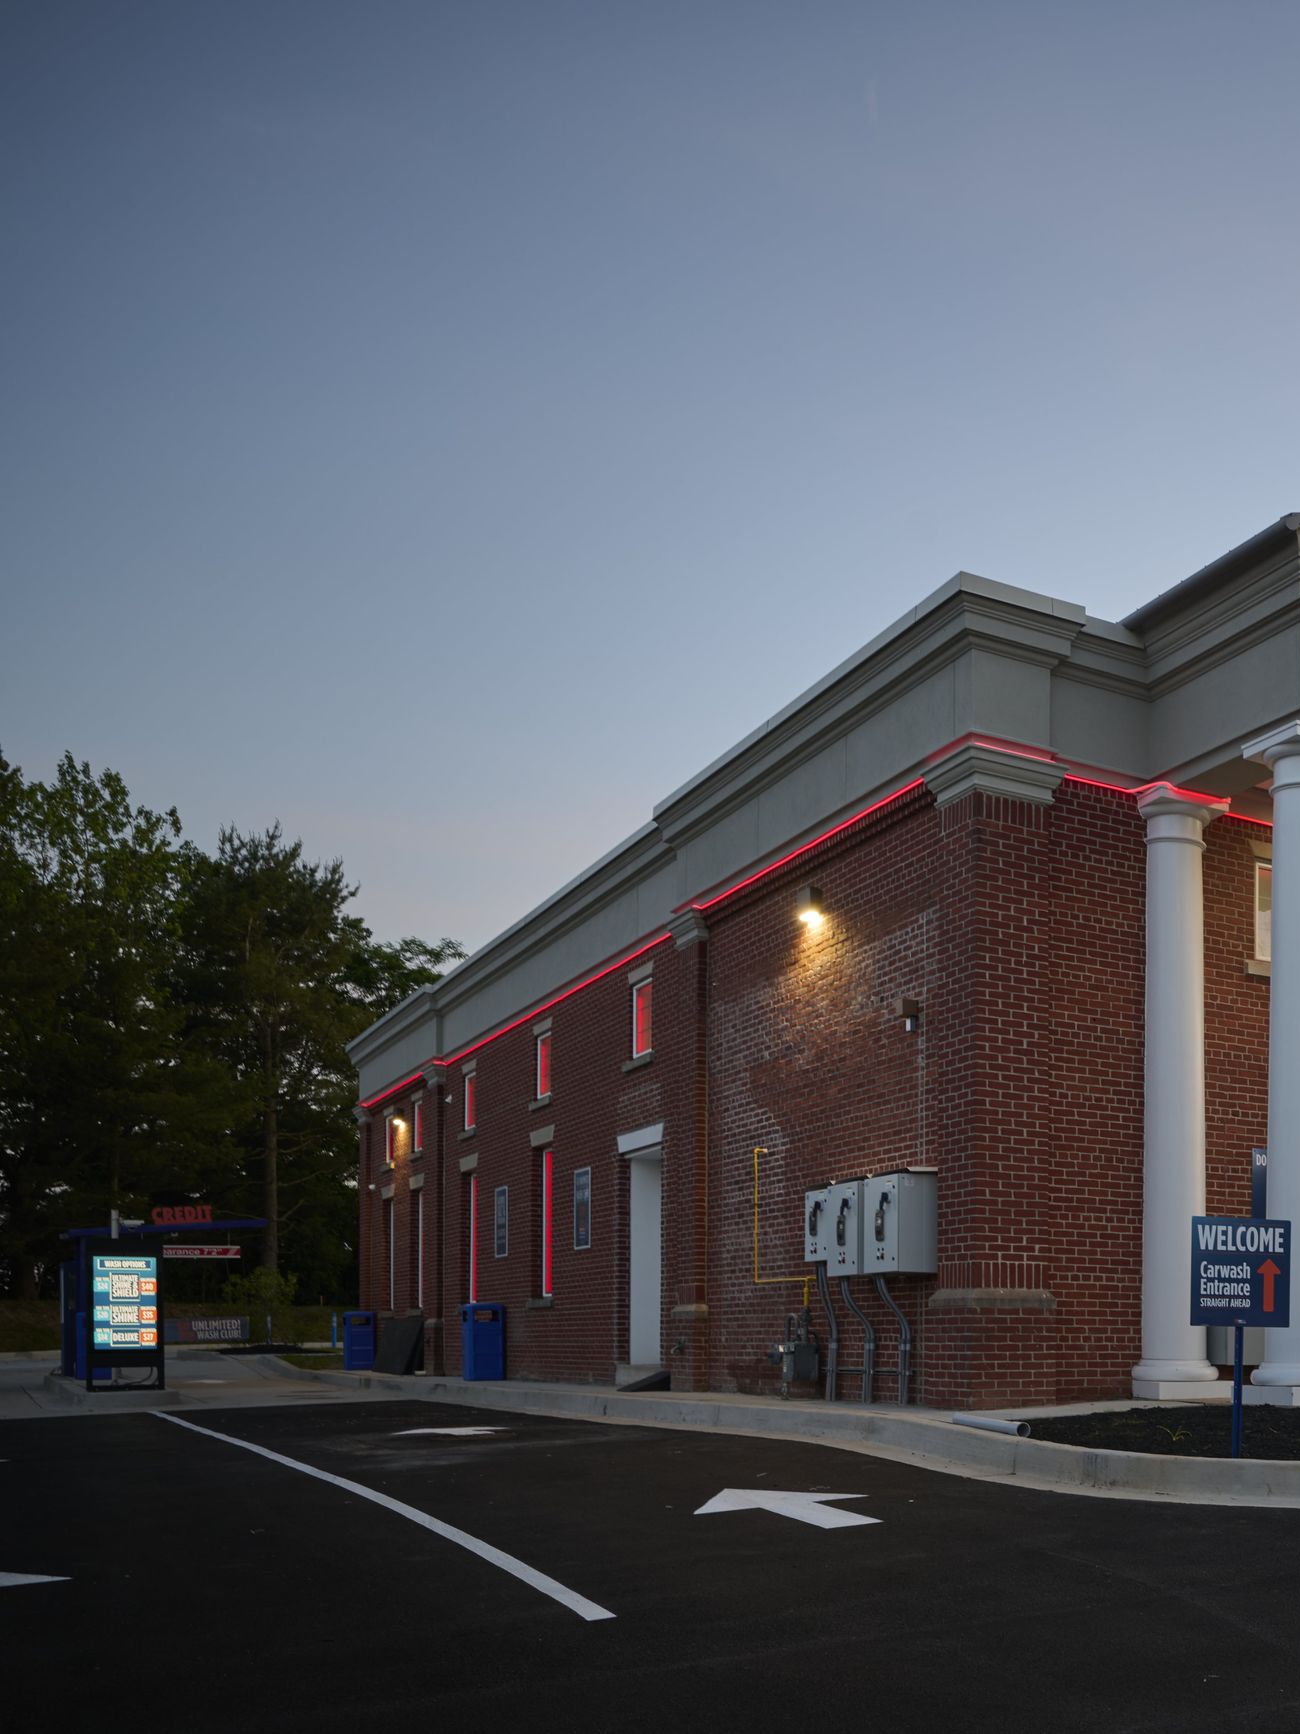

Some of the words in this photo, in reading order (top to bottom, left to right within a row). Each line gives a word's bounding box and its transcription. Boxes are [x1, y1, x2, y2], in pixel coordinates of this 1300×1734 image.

[151, 1204, 213, 1222] CREDIT
[1197, 1224, 1284, 1253] WELCOME
[103, 1260, 122, 1268] WASH
[122, 1260, 147, 1268] OPTIONS
[1200, 1261, 1251, 1279] Carwash
[1200, 1278, 1251, 1296] Entrance
[1200, 1297, 1229, 1307] STRAIGHT
[1230, 1298, 1251, 1308] AHEAD
[112, 1312, 139, 1323] SHINE
[191, 1319, 241, 1330] UNLIMITED!
[112, 1332, 139, 1342] DELUXE
[197, 1330, 220, 1340] WASH
[220, 1330, 242, 1339] CLUB!
